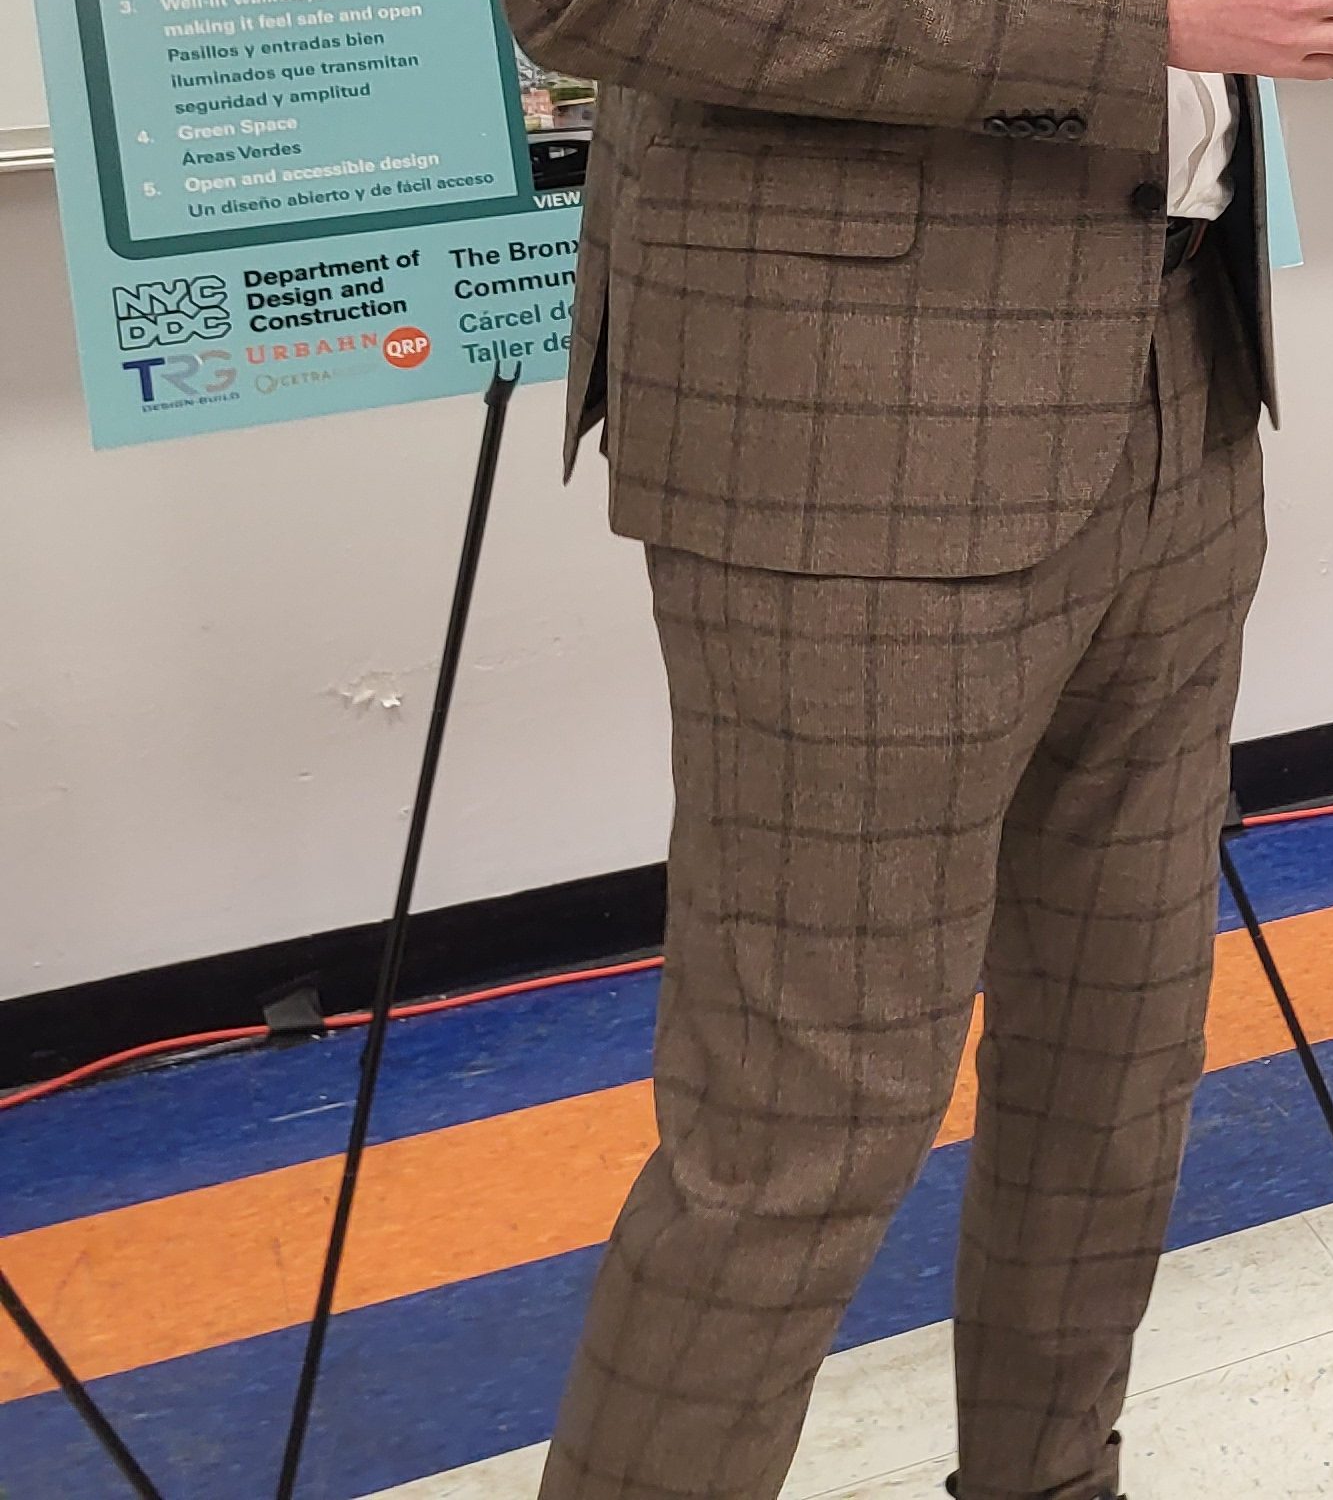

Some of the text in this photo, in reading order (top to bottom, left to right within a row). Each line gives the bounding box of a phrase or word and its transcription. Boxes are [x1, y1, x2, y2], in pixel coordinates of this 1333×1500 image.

[177, 124, 238, 140] Green
[240, 118, 297, 136] Space
[237, 142, 302, 159] Verdes
[143, 153, 441, 197] 5. Open and accessible design
[188, 172, 494, 218] Un diseño abierto y de fácil acceso
[243, 250, 420, 288] Department of
[113, 275, 228, 320] NYC
[247, 277, 384, 310] Design and
[117, 307, 232, 351] DDC
[249, 299, 407, 332] Construction
[385, 337, 428, 358] QRP
